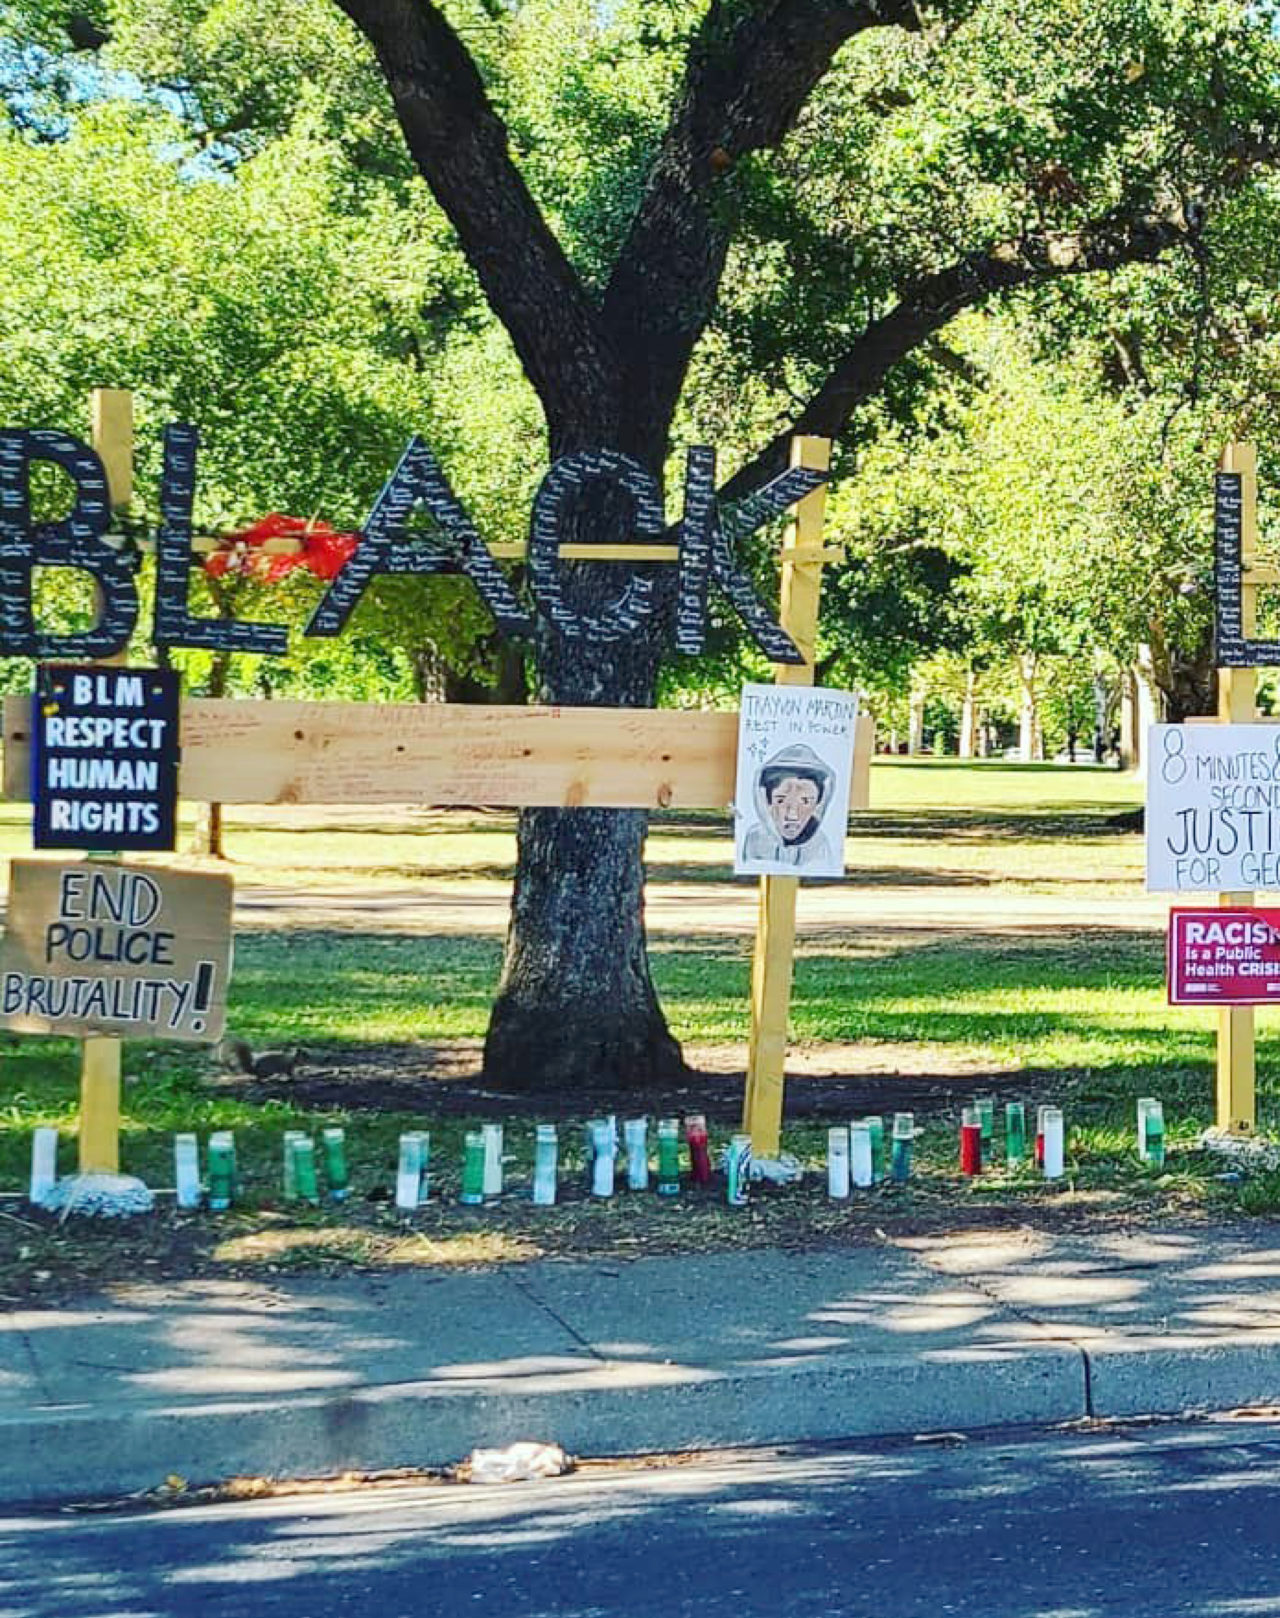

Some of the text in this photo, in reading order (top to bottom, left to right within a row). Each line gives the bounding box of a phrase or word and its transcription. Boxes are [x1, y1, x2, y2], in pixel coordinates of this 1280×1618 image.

[0, 424, 826, 664] BLACK
[73, 675, 145, 707] BLM
[806, 697, 855, 720] MARTIN
[45, 717, 167, 749] RESPECT
[790, 721, 802, 734] IN
[1162, 728, 1187, 784] 8
[1196, 753, 1271, 781] MINUTES
[47, 758, 158, 791] HUMAN
[51, 799, 160, 833] RIGHTS
[1175, 857, 1221, 889] FOR
[60, 872, 160, 928] END
[46, 923, 176, 966] POLICE
[1215, 946, 1262, 960] Public
[1185, 962, 1234, 976] Health
